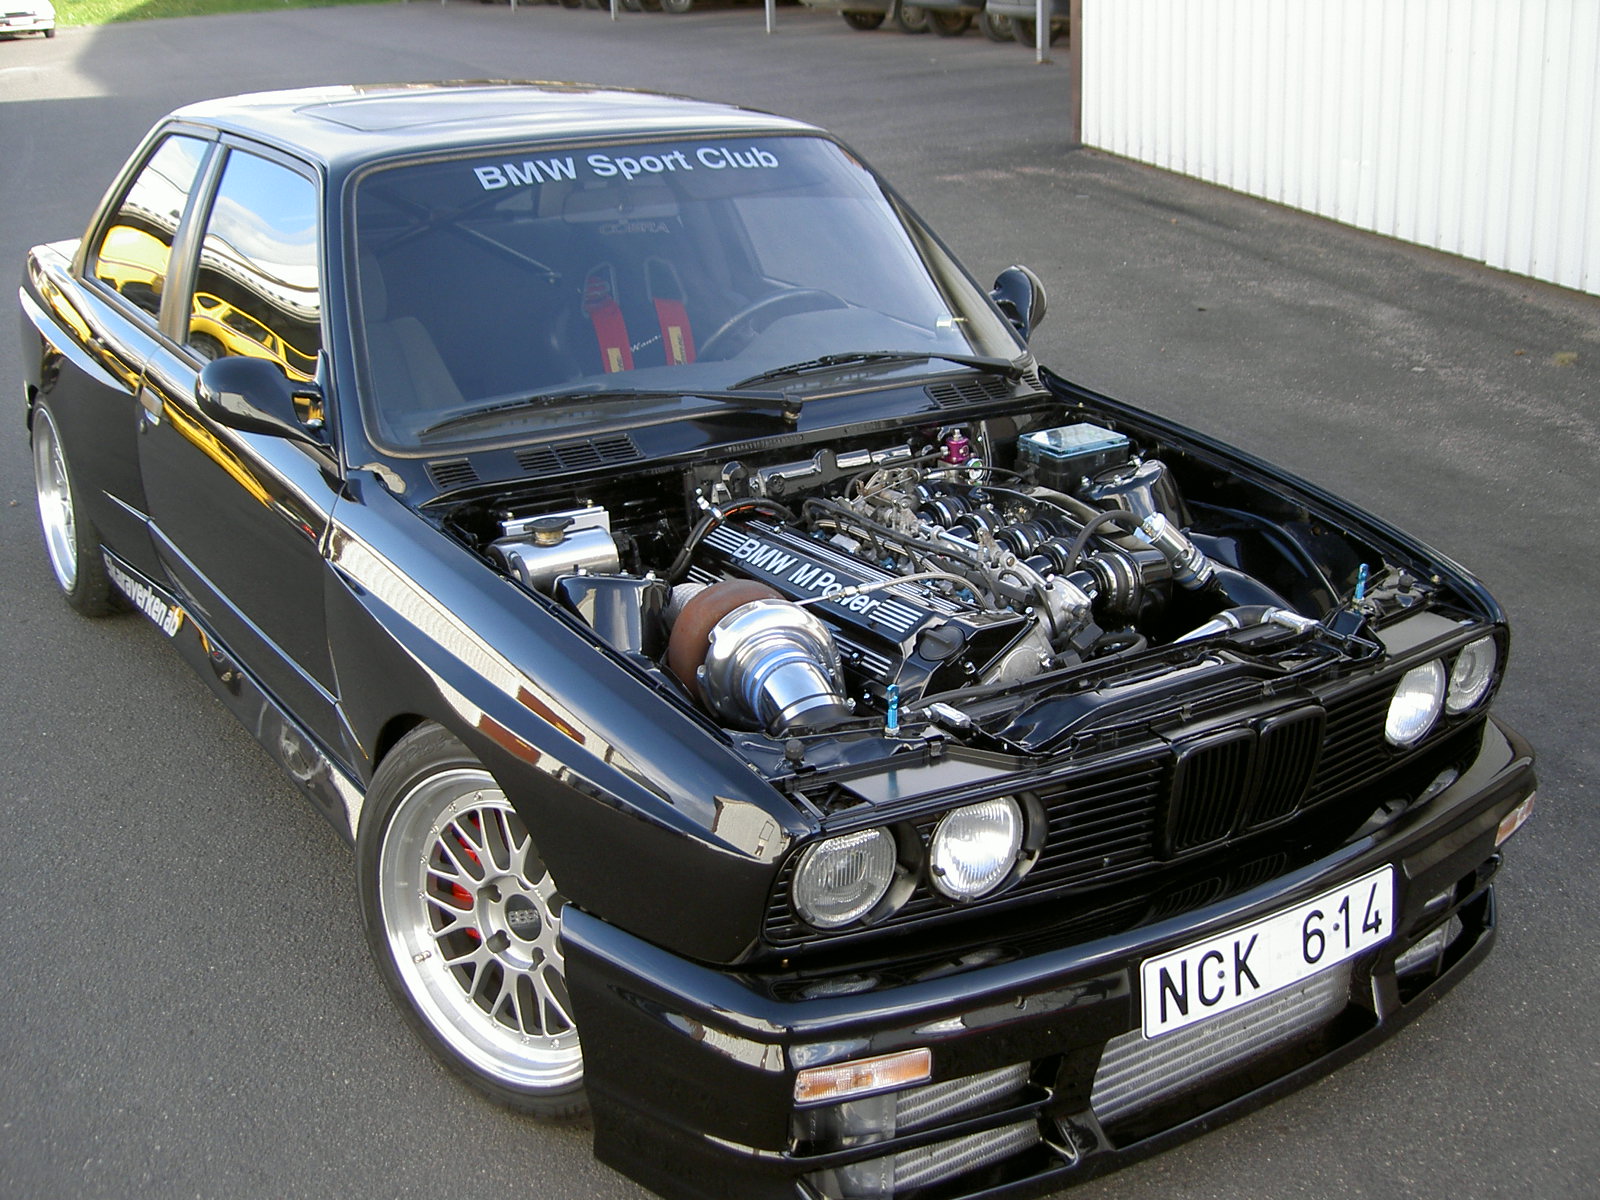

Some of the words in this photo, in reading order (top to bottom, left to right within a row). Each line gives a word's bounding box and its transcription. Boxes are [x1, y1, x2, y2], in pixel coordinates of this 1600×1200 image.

[473, 157, 577, 191] BMW
[586, 149, 693, 180] Sport
[696, 146, 779, 169] Club
[732, 538, 798, 575] BMW
[1159, 933, 1261, 1024] NCK
[1302, 882, 1383, 964] 614
